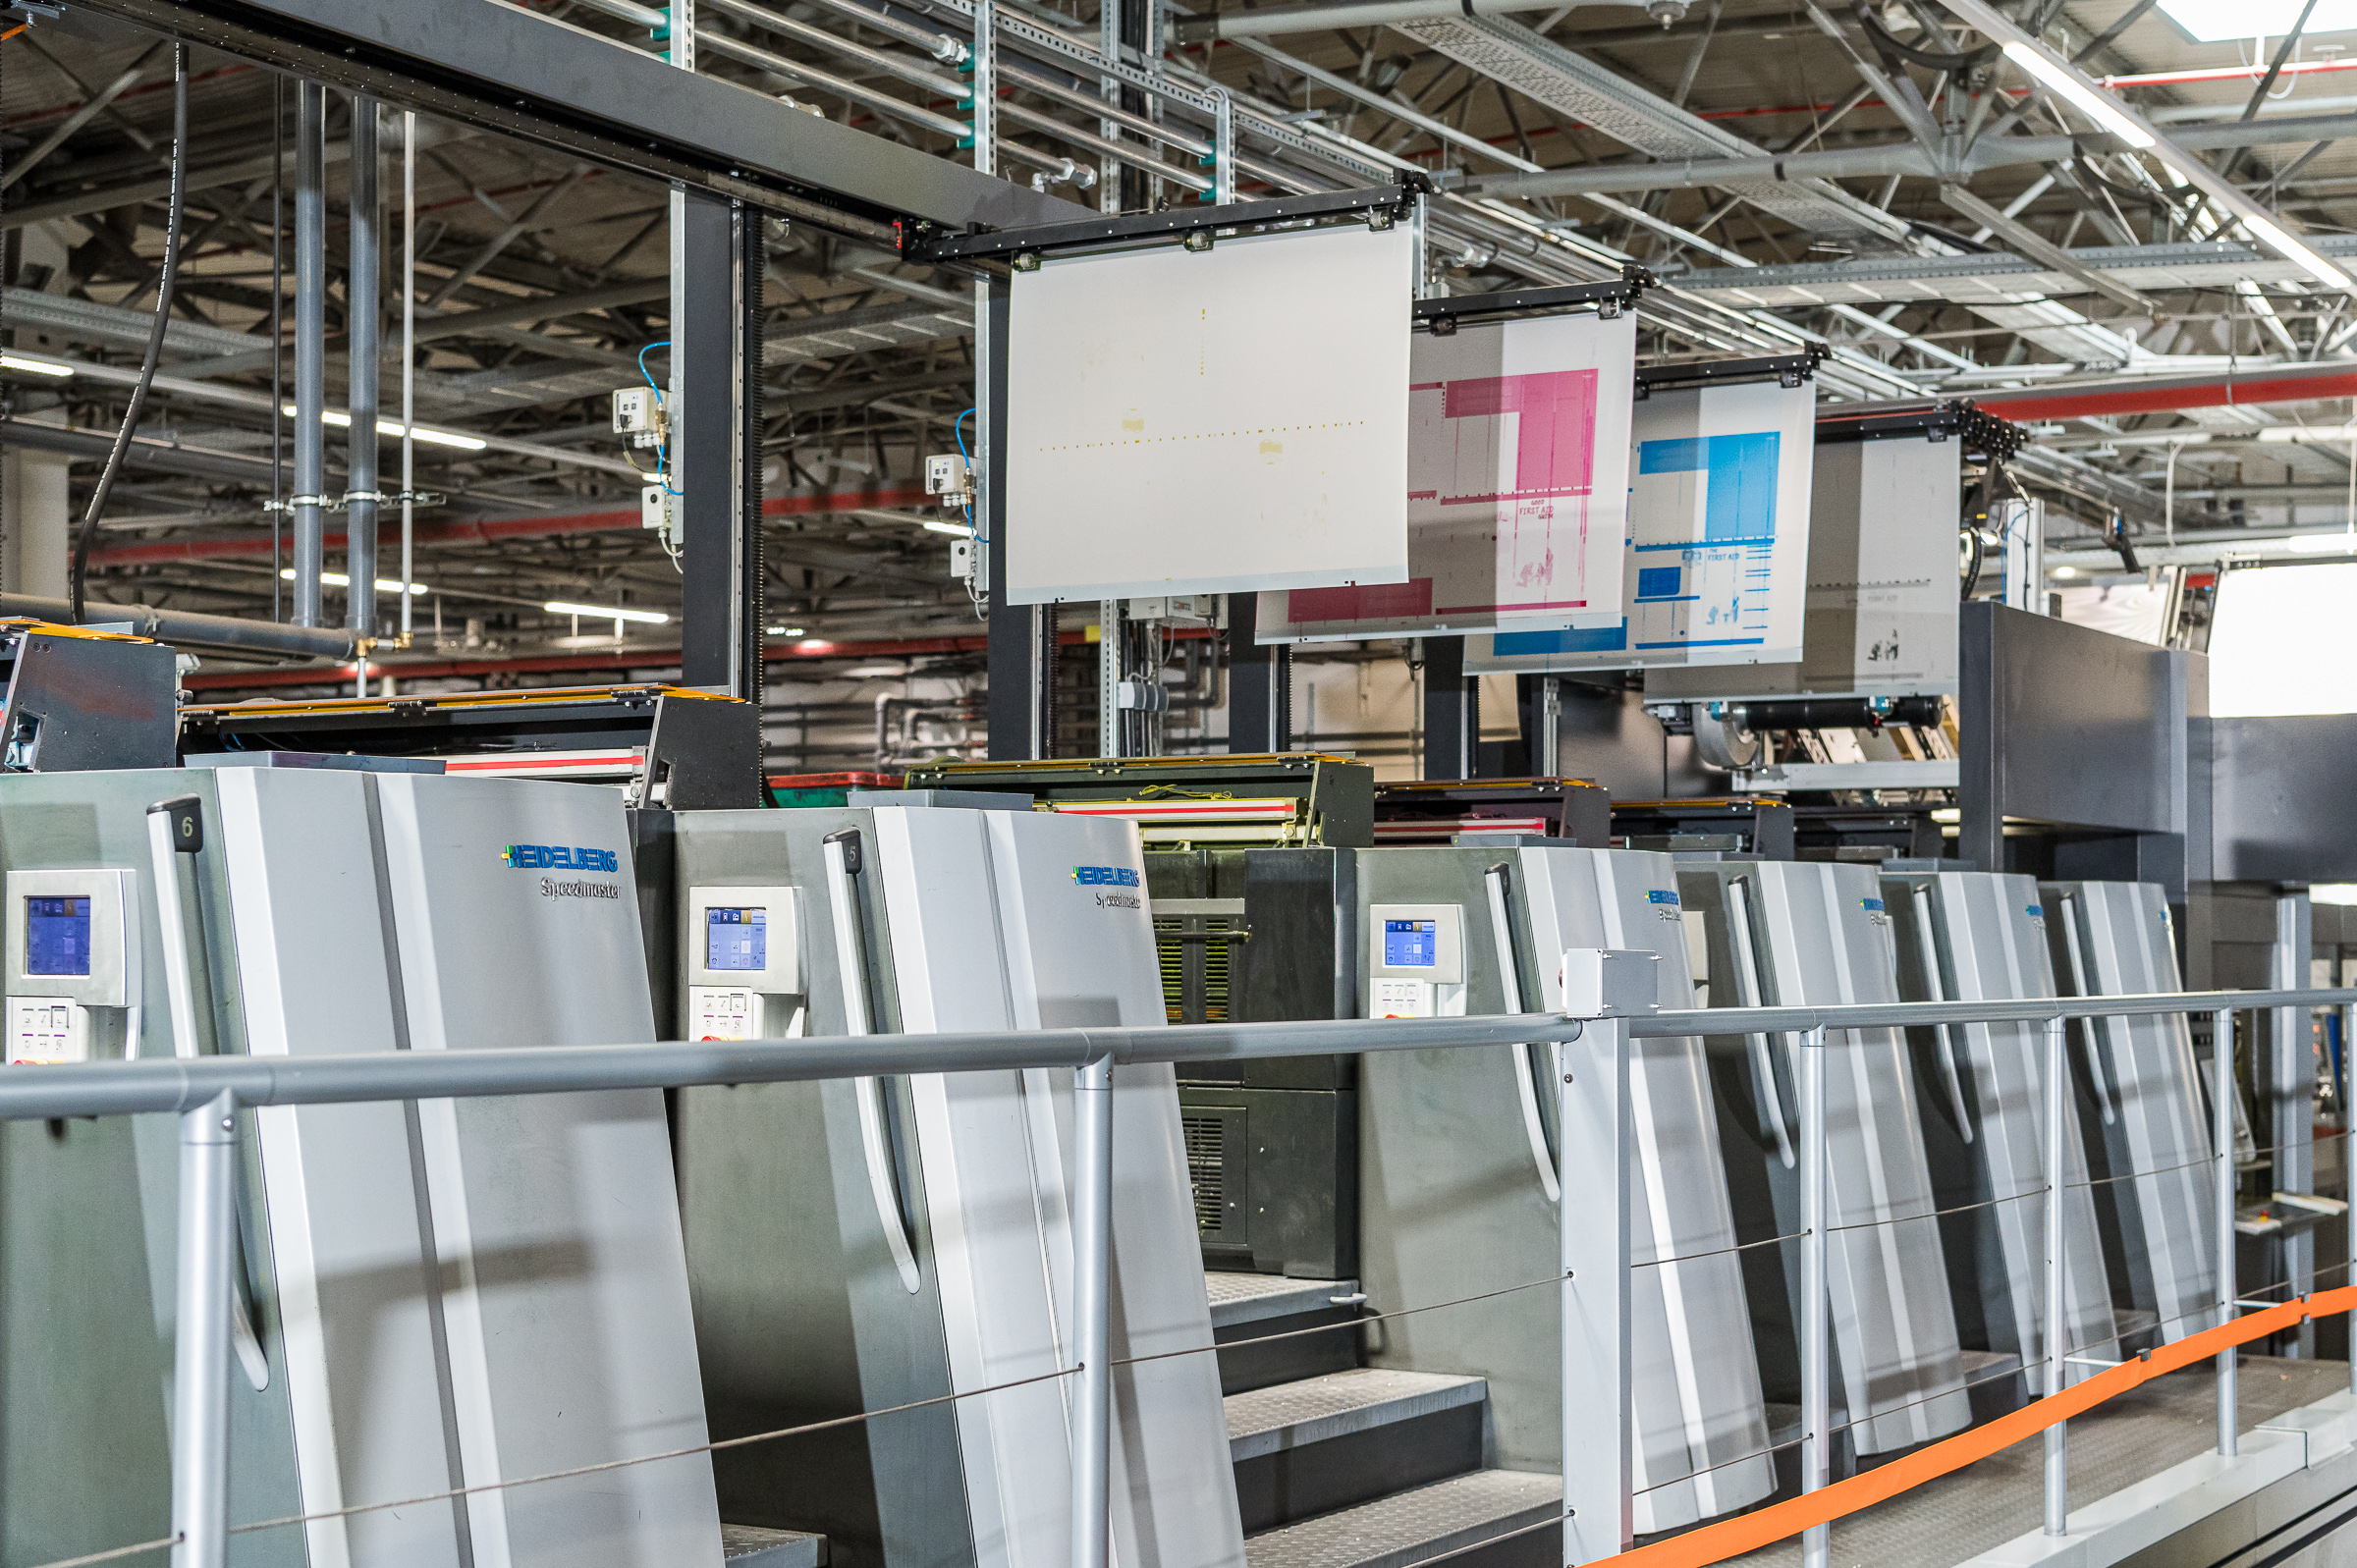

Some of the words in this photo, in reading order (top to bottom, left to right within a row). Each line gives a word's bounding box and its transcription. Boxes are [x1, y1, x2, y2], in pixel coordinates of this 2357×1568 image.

[1519, 506, 1540, 515] FIRST
[1541, 505, 1555, 514] AID
[1707, 553, 1727, 562] FIRST
[182, 816, 193, 838] 6
[501, 844, 618, 873] HEIDELBERG
[849, 846, 856, 862] 5
[1070, 866, 1139, 887] HEIDELBERG
[541, 877, 621, 901] Speedmaster
